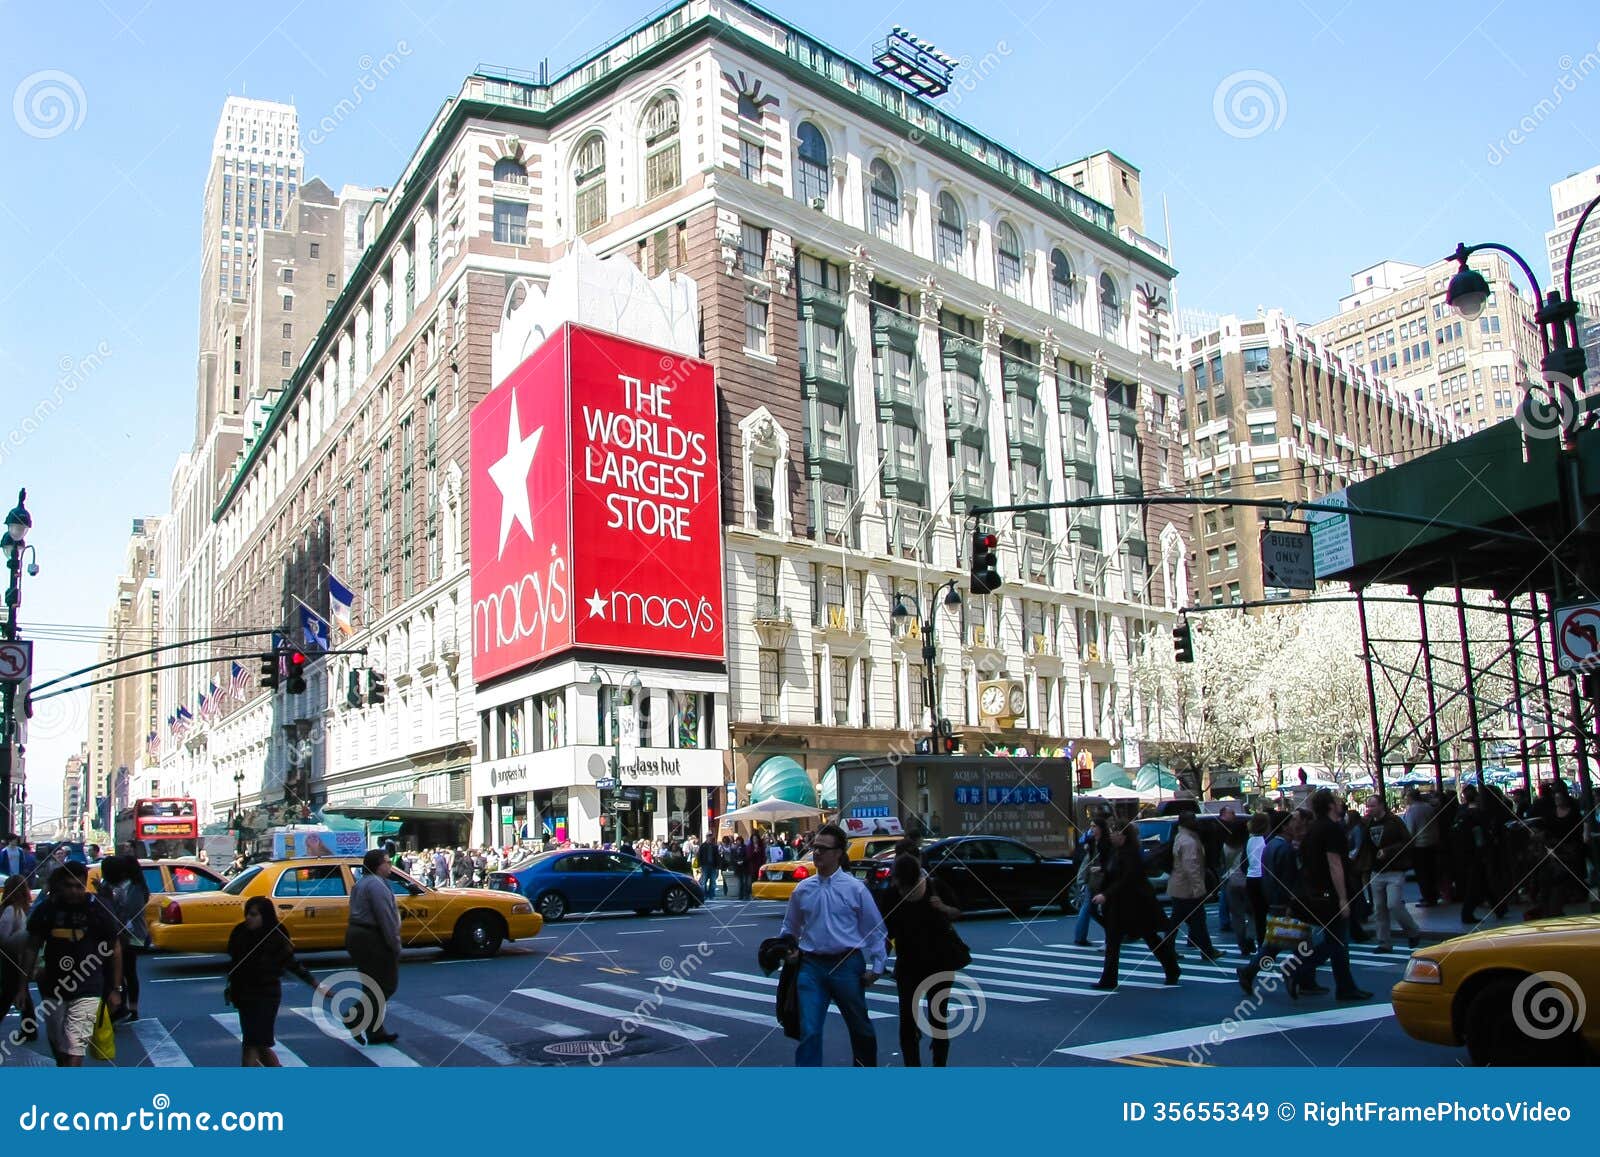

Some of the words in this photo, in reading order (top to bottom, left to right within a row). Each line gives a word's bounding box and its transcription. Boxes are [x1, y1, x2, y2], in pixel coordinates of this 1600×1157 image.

[618, 374, 672, 420] THE
[583, 405, 707, 466] WORLD'S
[586, 446, 705, 504] LARGEST
[607, 493, 692, 542] STORE
[1271, 535, 1304, 549] BUSES
[1275, 551, 1300, 564] ONLY
[473, 543, 567, 657] macy's
[612, 590, 714, 638] macy's
[660, 756, 681, 776] hut
